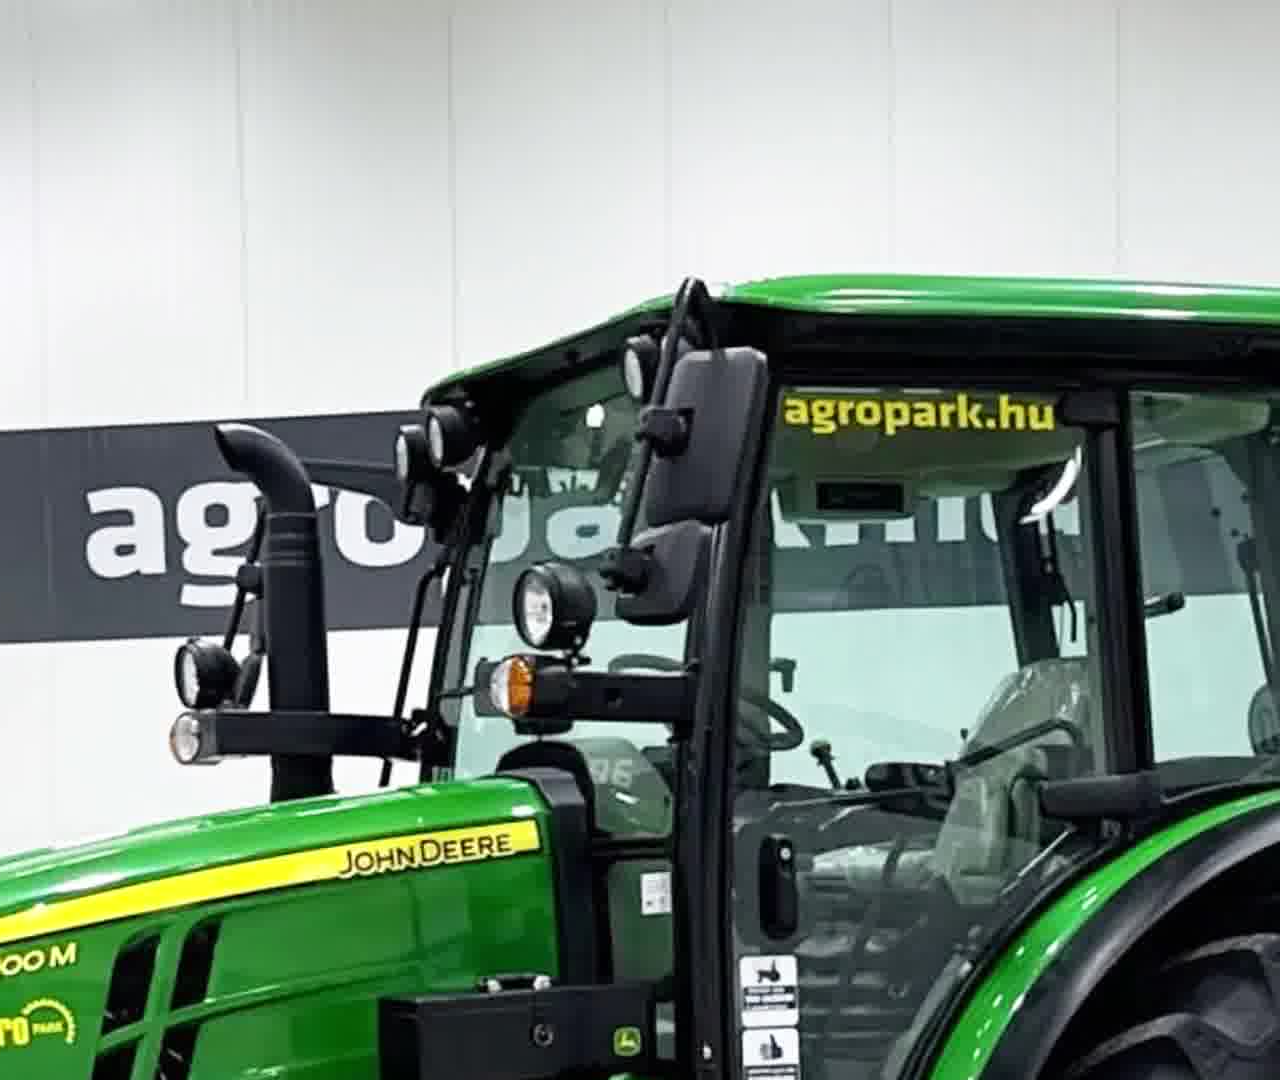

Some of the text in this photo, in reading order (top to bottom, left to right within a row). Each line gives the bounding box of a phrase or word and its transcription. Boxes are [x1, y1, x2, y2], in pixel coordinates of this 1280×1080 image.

[784, 393, 1055, 436] agropark.hu
[340, 833, 512, 875] JOHN DEERE
